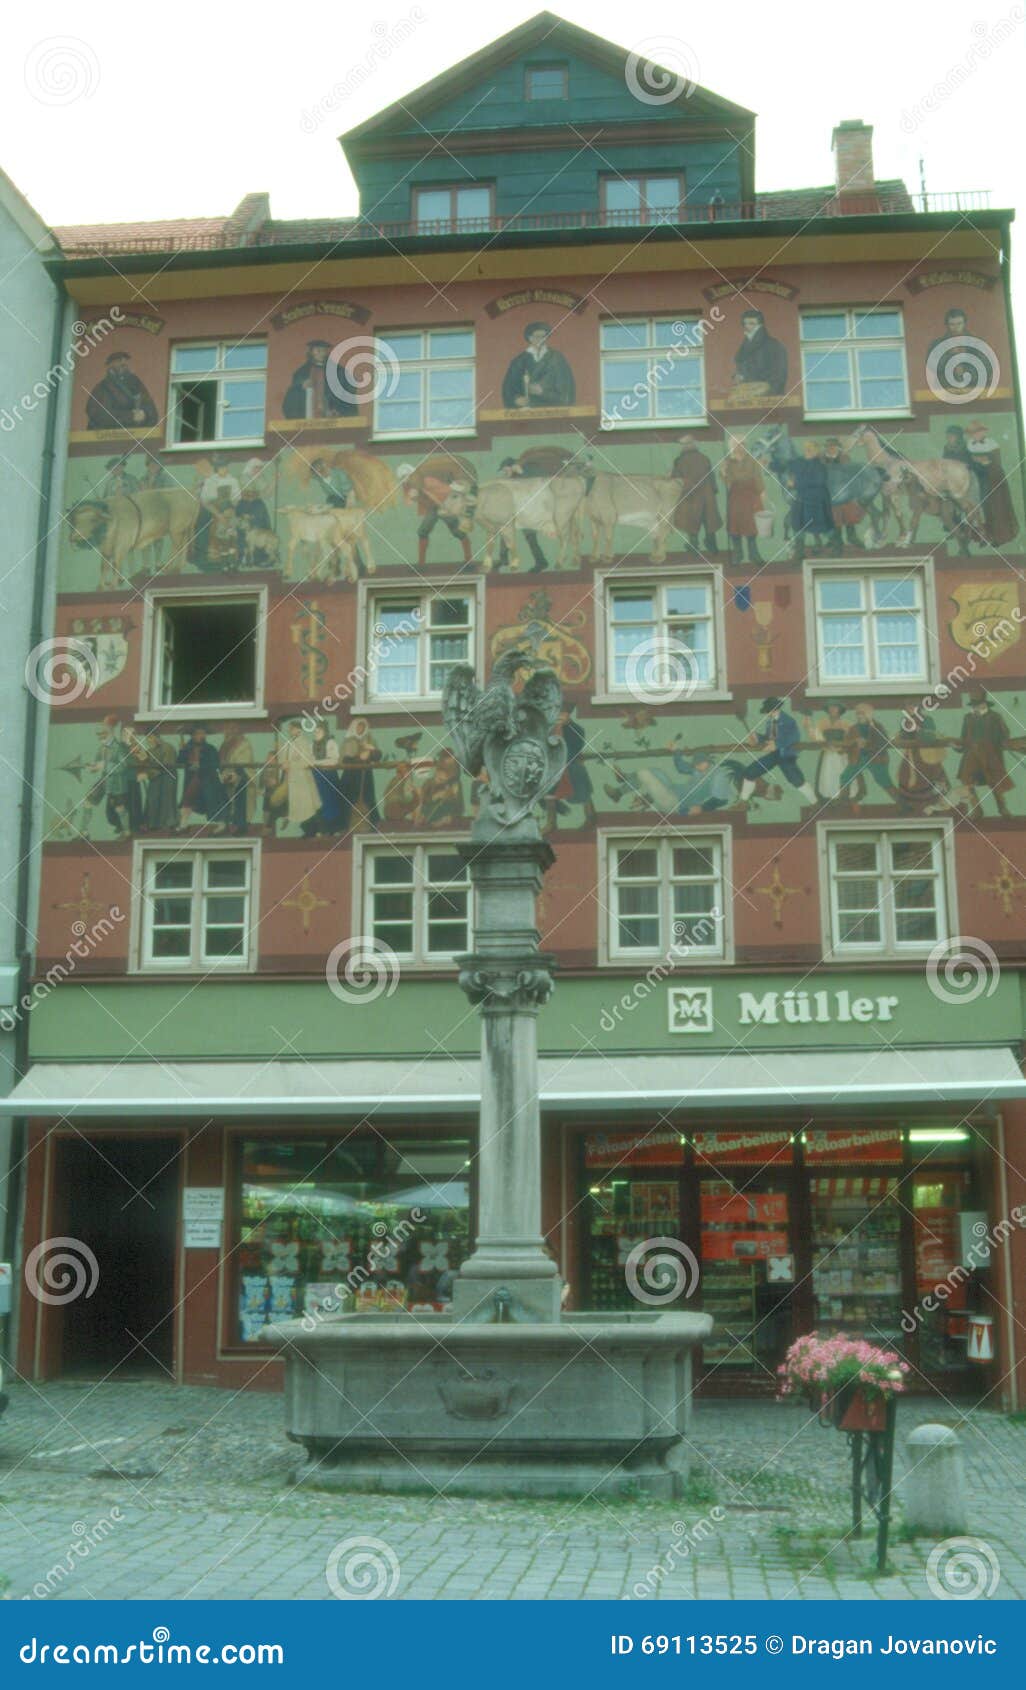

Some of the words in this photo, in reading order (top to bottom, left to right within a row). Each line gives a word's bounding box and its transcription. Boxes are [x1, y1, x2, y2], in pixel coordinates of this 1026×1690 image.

[738, 990, 898, 1024] Müller
[694, 1131, 787, 1154] Fotoarbeiten
[806, 1130, 898, 1153] Fotoarbeiten
